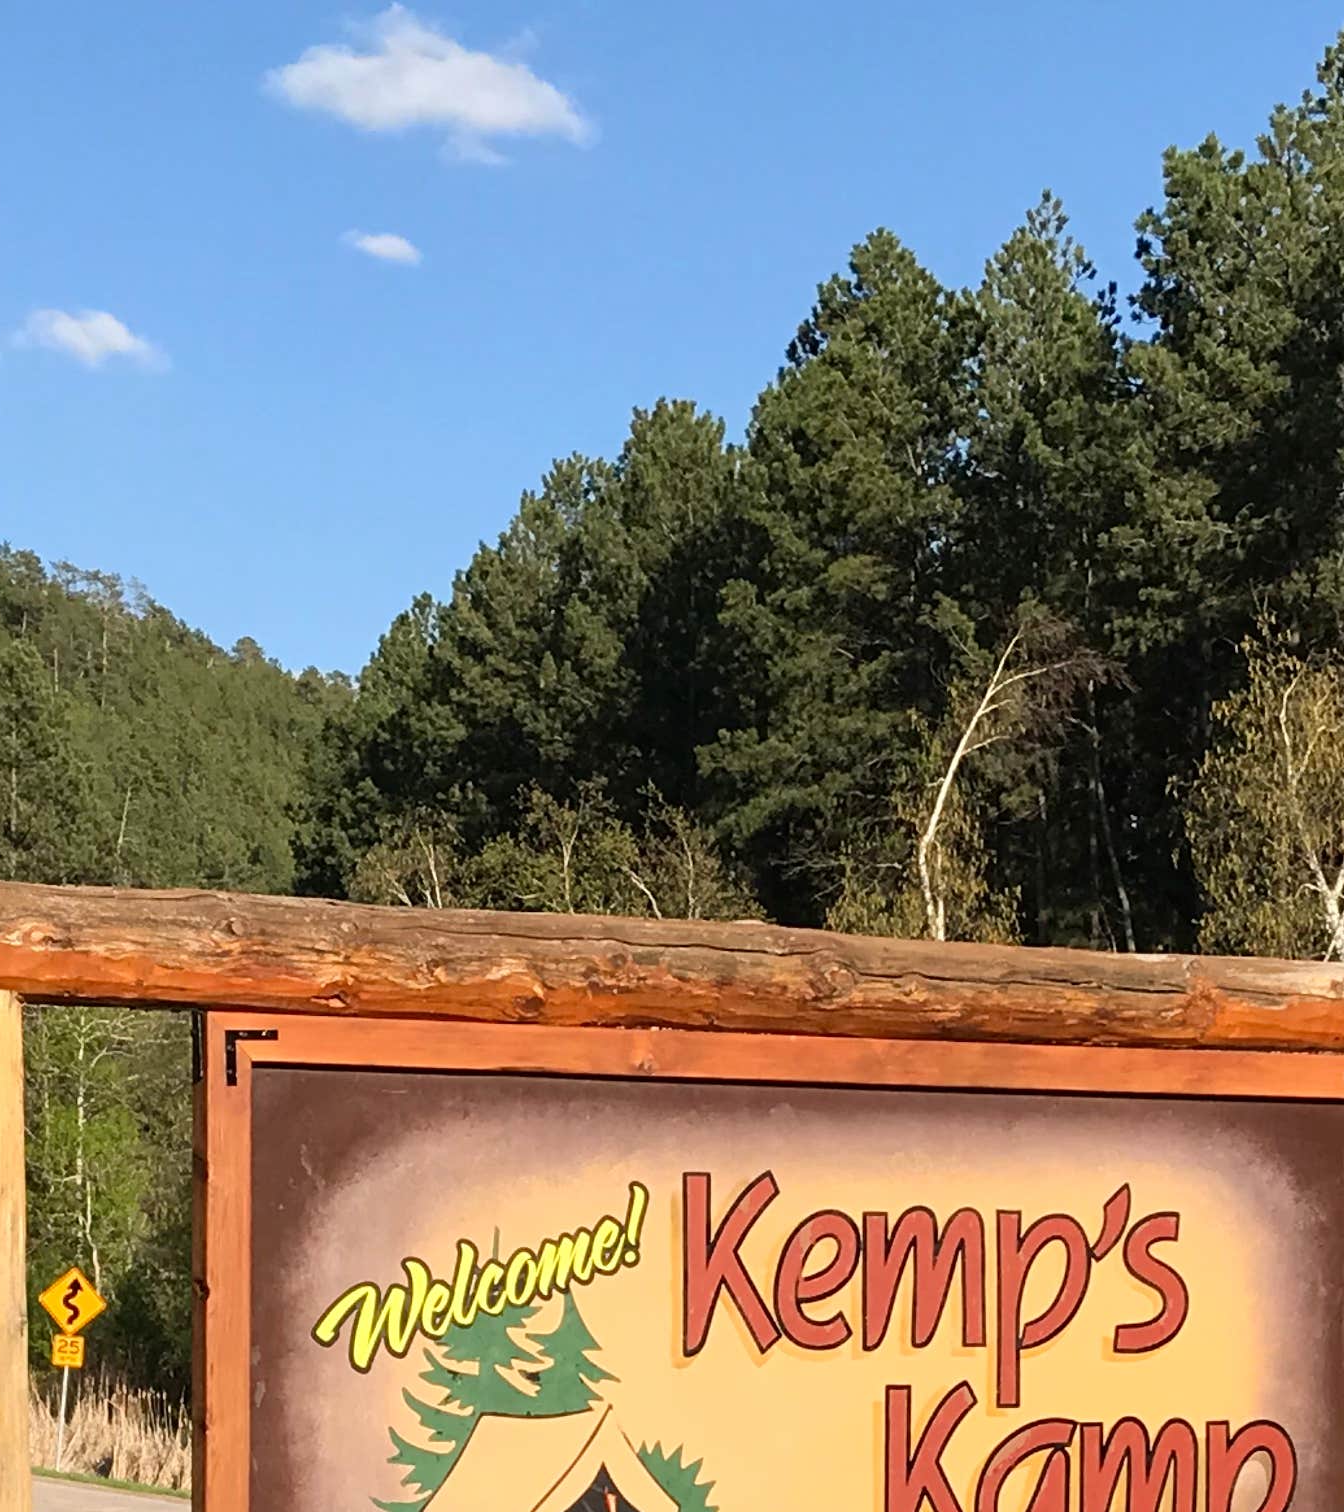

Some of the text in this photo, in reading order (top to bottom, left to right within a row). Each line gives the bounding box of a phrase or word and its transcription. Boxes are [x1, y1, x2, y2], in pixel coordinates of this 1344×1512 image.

[57, 1339, 80, 1354] 25
[311, 1180, 649, 1374] Welcome!
[682, 1170, 1190, 1409] Kemp's
